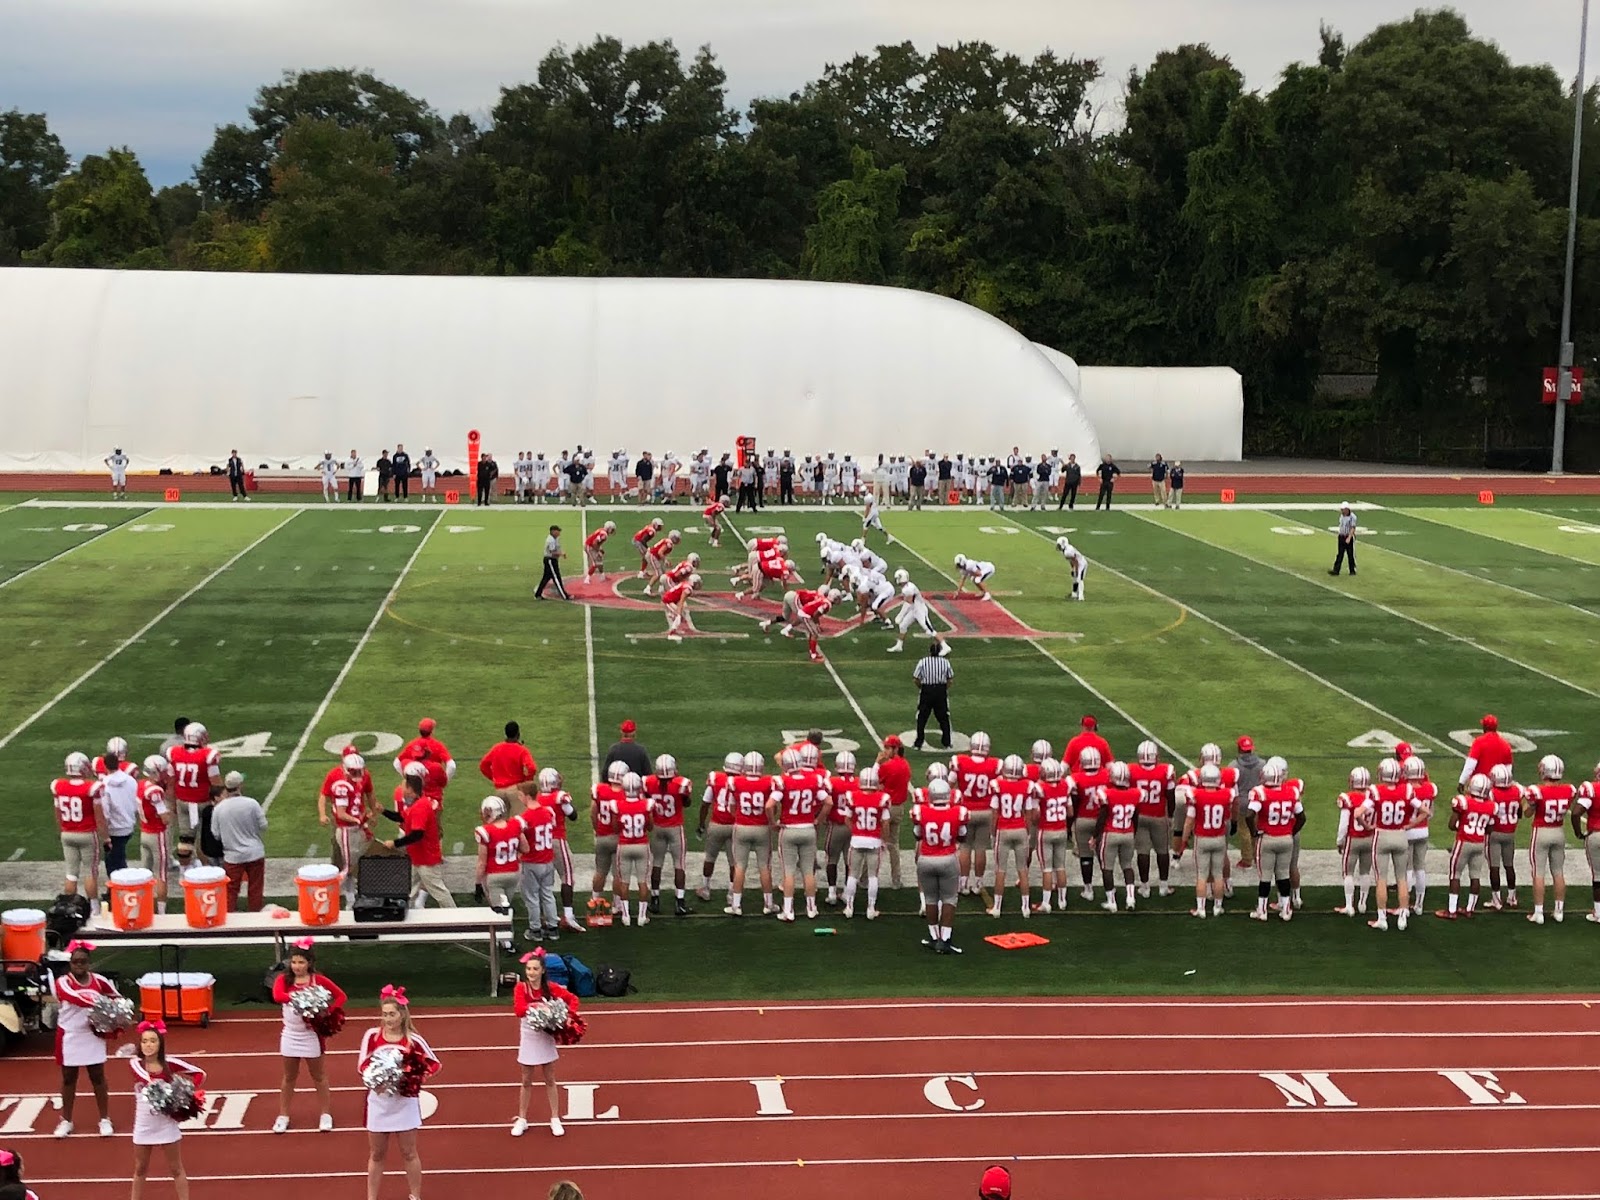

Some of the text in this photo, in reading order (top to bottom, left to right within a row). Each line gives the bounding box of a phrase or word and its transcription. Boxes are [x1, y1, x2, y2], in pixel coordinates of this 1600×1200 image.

[175, 762, 199, 788] 77
[963, 773, 989, 798] 79
[739, 791, 765, 816] 69
[788, 788, 813, 816] 72
[1136, 780, 1161, 804] 52
[58, 795, 83, 823] 58
[1001, 792, 1024, 819] 84
[1046, 796, 1067, 822] 25
[1111, 804, 1136, 829] 22
[1267, 801, 1293, 826] 65
[1381, 800, 1406, 826] 86
[620, 813, 646, 839] 38
[854, 806, 878, 832] 36
[1463, 811, 1490, 836] 30
[534, 824, 554, 852] 56
[925, 821, 952, 847] 64
[494, 838, 520, 865] 60
[123, 892, 138, 908] G
[202, 890, 216, 906] G
[313, 887, 328, 903] G
